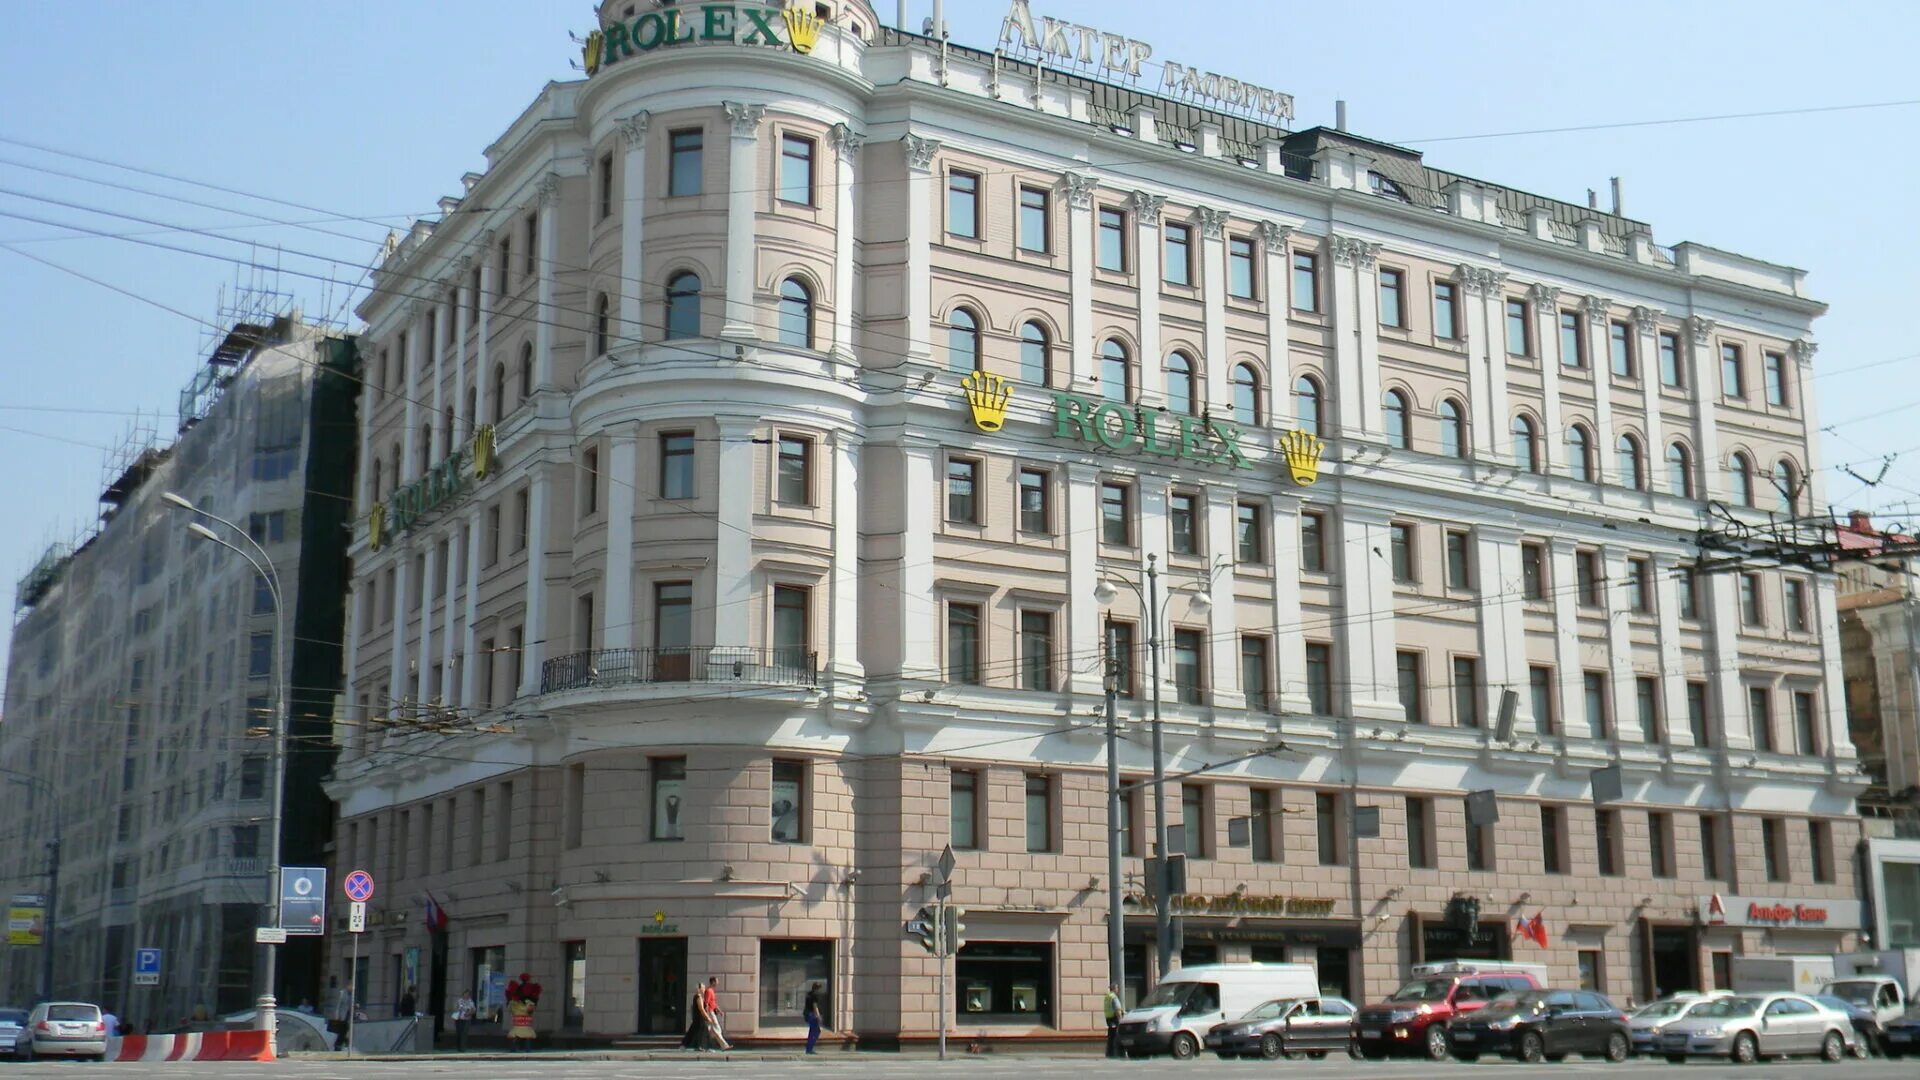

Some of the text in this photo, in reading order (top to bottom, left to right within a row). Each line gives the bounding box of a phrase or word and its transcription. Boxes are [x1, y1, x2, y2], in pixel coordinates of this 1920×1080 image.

[603, 6, 783, 65] ROLEX
[1000, 0, 1295, 121] АКТЕР ГАЛЕРЕЯ
[1052, 393, 1254, 470] ROLEX
[141, 951, 156, 970] P
